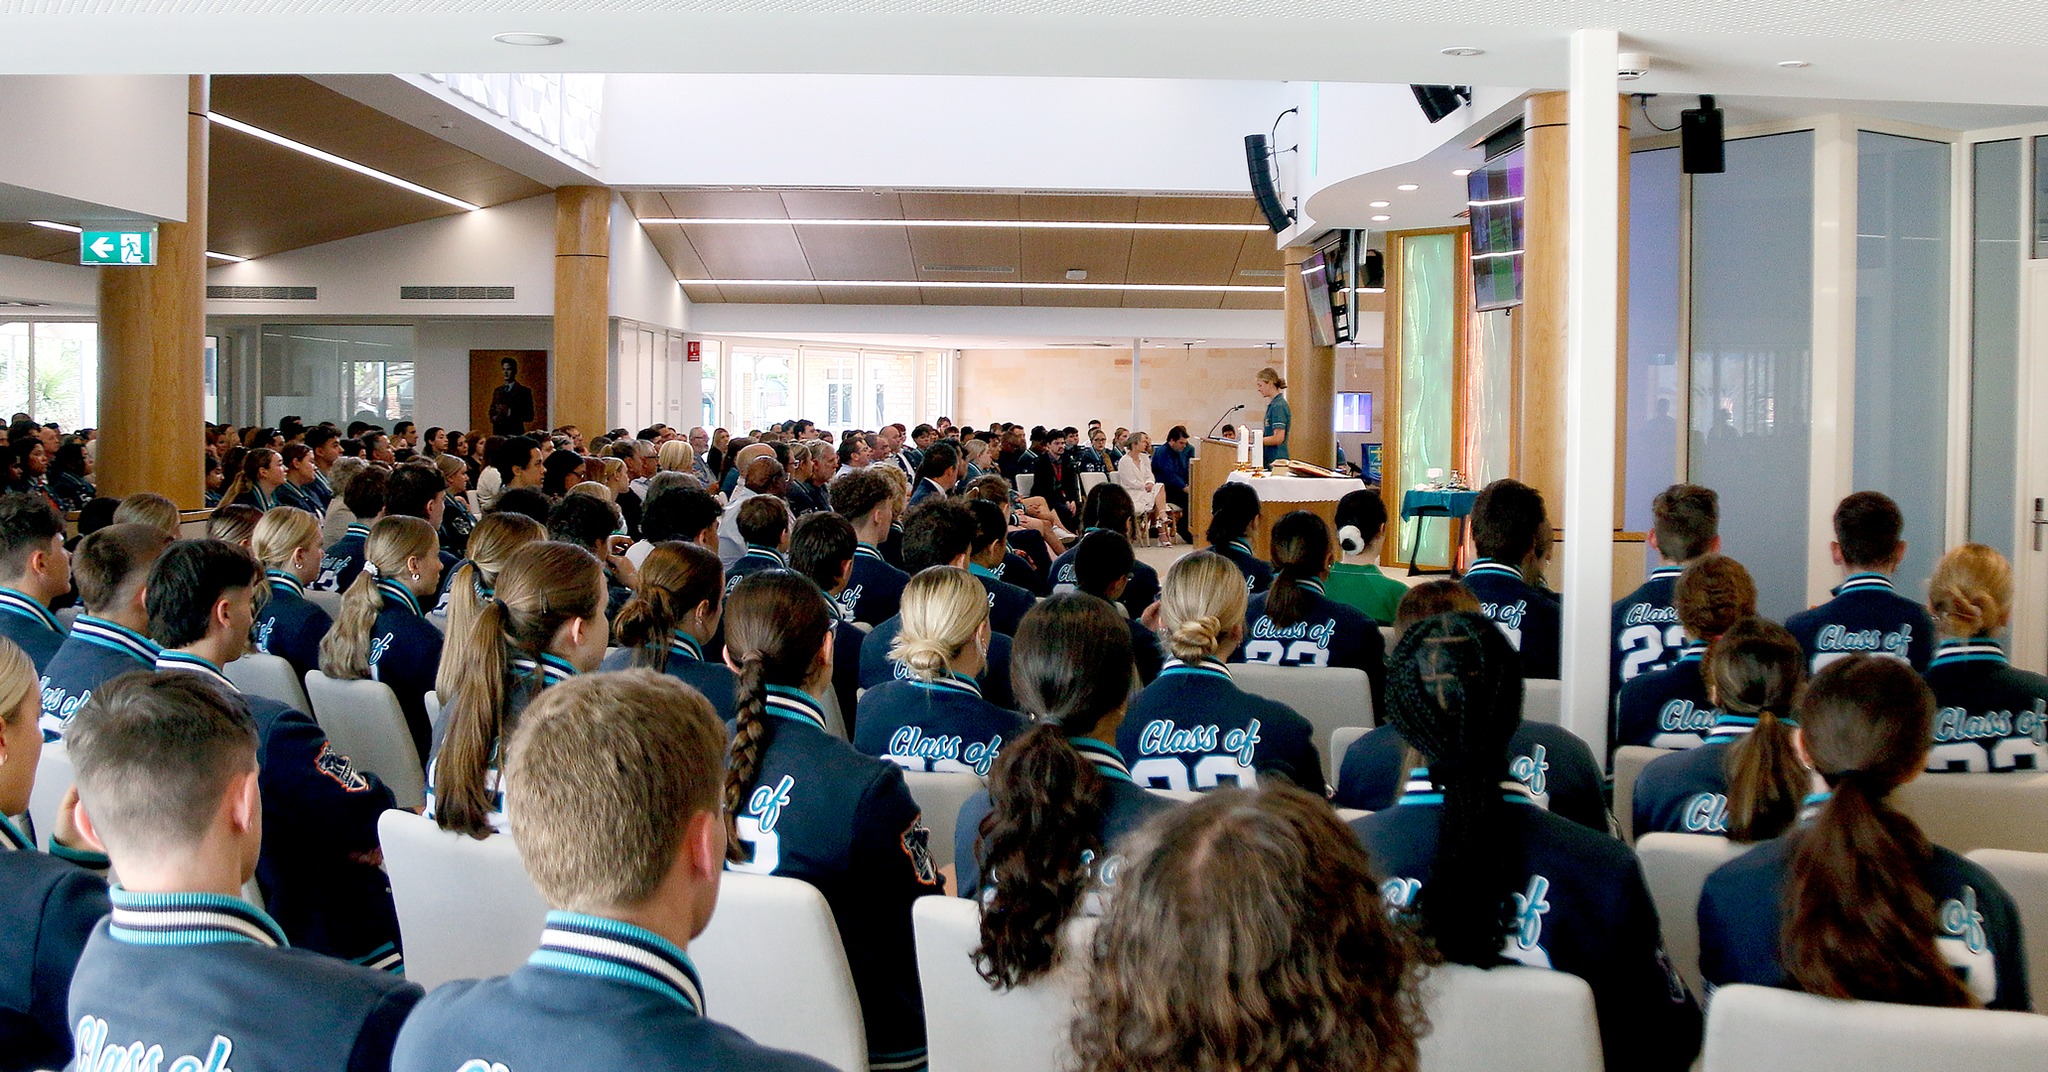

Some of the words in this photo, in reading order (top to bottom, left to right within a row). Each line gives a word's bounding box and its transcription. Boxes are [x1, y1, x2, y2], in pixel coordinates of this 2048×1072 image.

[842, 584, 863, 611] of
[1500, 599, 1527, 630] of
[1309, 618, 1337, 650] of
[1818, 624, 1882, 651] Class
[1883, 623, 1914, 658] of
[1138, 718, 1220, 756] Class
[1224, 717, 1262, 767] of
[1933, 705, 2014, 742] Class
[2015, 697, 2048, 746] of
[889, 725, 963, 760] Class
[964, 733, 1003, 776] of
[1508, 743, 1550, 796] of
[748, 774, 795, 834] of
[1940, 884, 1985, 956] of
